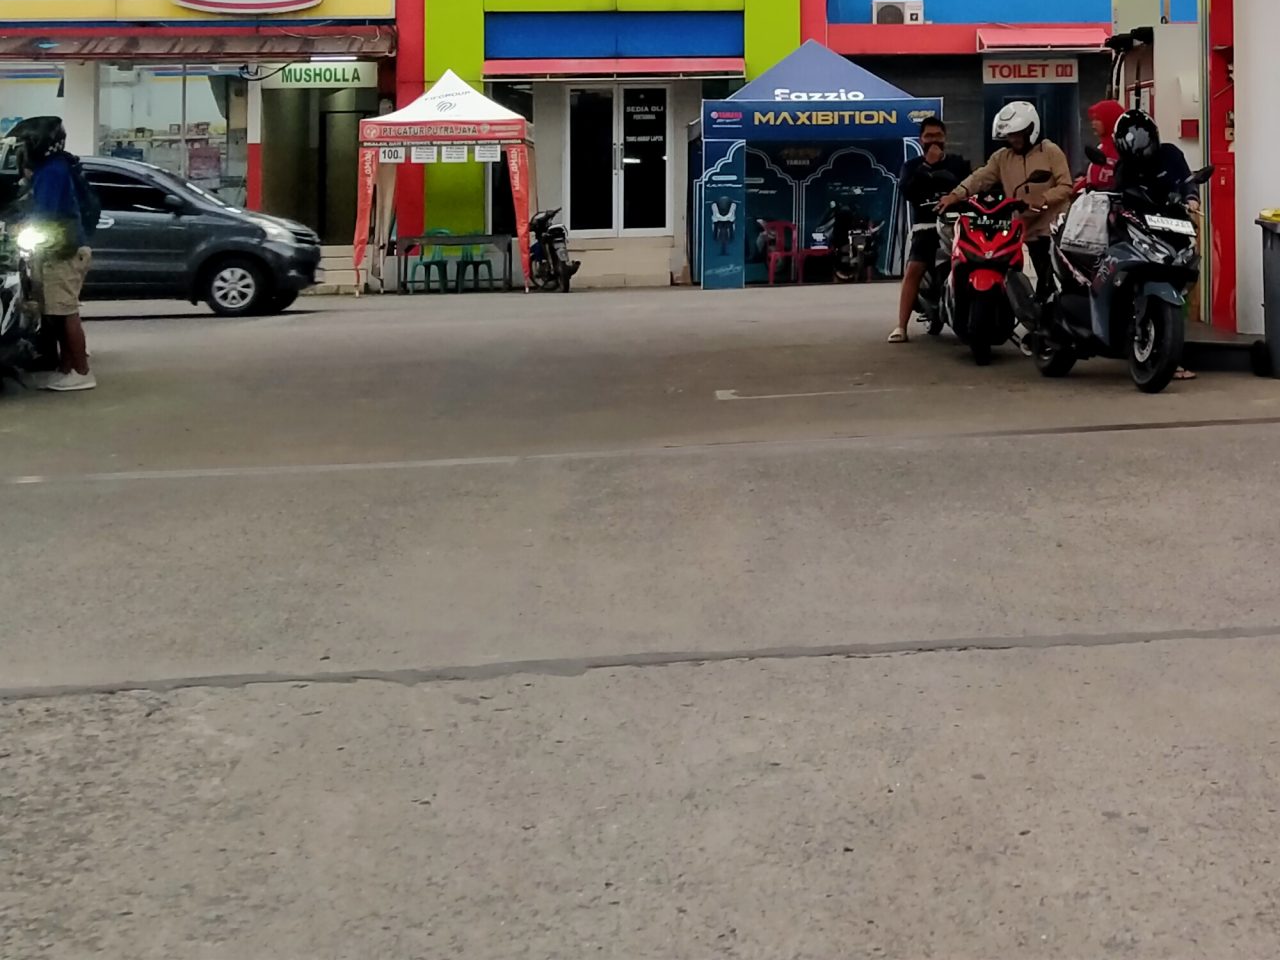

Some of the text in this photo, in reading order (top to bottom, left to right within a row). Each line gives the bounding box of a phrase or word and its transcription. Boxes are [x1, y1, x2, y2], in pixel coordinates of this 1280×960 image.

[281, 67, 361, 83] MUSHOLLA
[988, 64, 1049, 79] TOILET
[774, 89, 865, 101] Fazzio
[754, 110, 897, 125] MAXIBITION
[397, 127, 424, 136] CATUR
[427, 126, 454, 136] PUTRA
[457, 126, 478, 135] JAYA
